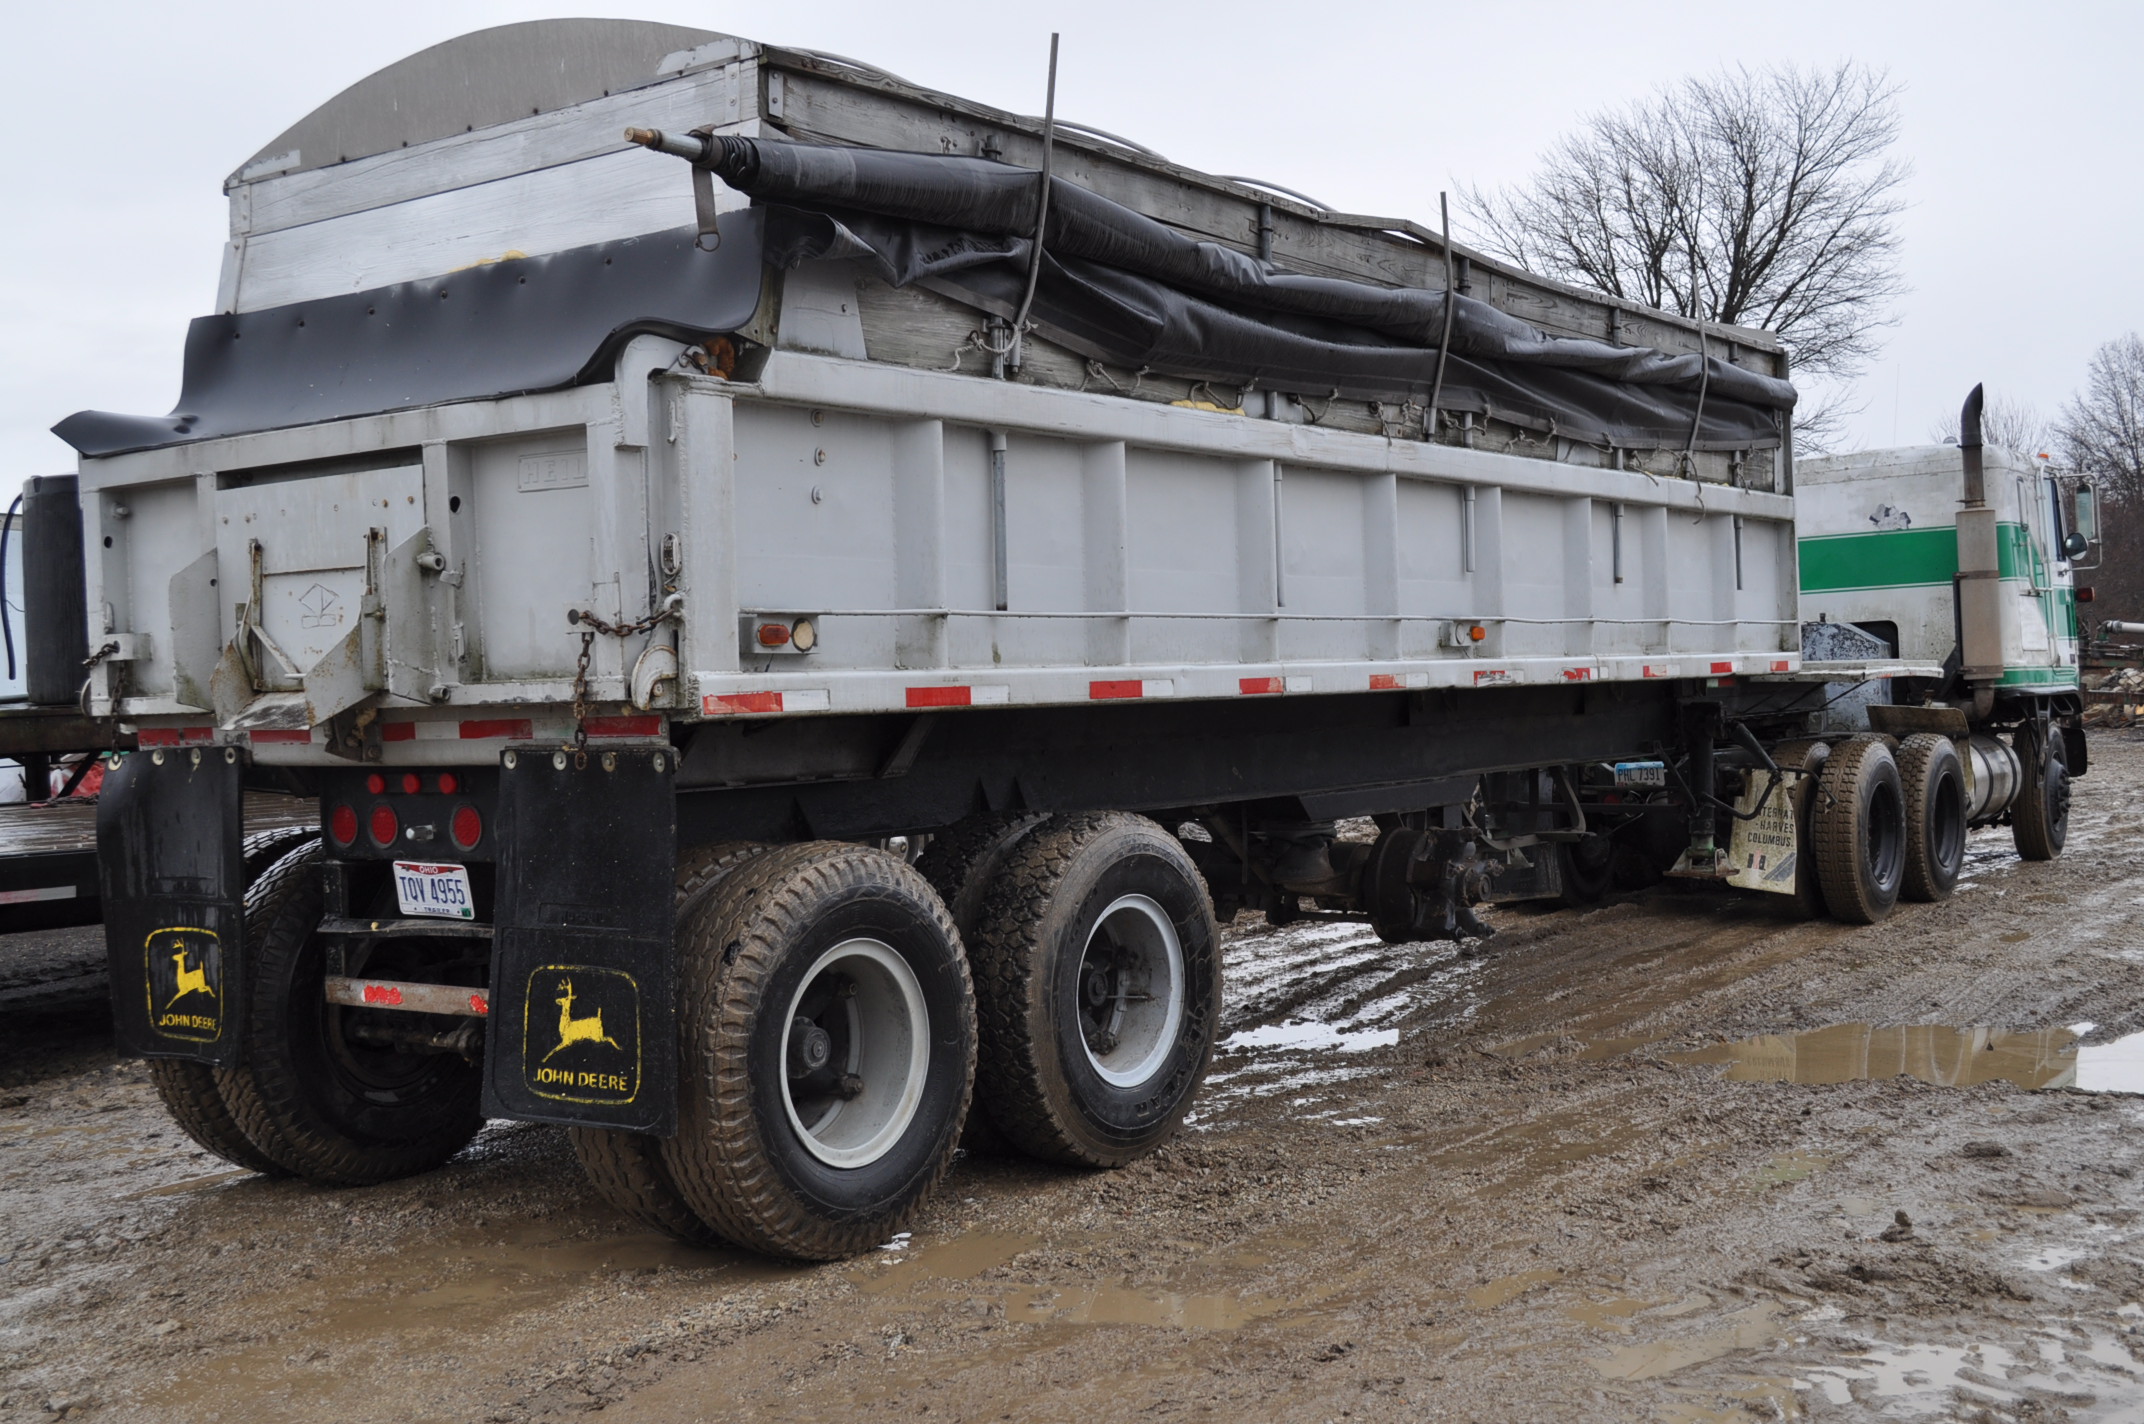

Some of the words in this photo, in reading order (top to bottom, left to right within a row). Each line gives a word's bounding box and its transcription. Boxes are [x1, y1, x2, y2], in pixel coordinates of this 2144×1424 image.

[523, 458, 587, 485] HEIL
[1638, 767, 1660, 781] 7391
[1758, 806, 1794, 820] TERNAT
[418, 865, 439, 874] OHIO
[399, 876, 426, 903] TQV
[430, 878, 466, 905] 4955
[159, 1013, 191, 1027] JOHN
[191, 1015, 217, 1031] DEERE
[533, 1068, 575, 1086] JOHN
[578, 1072, 629, 1091] DEERE
